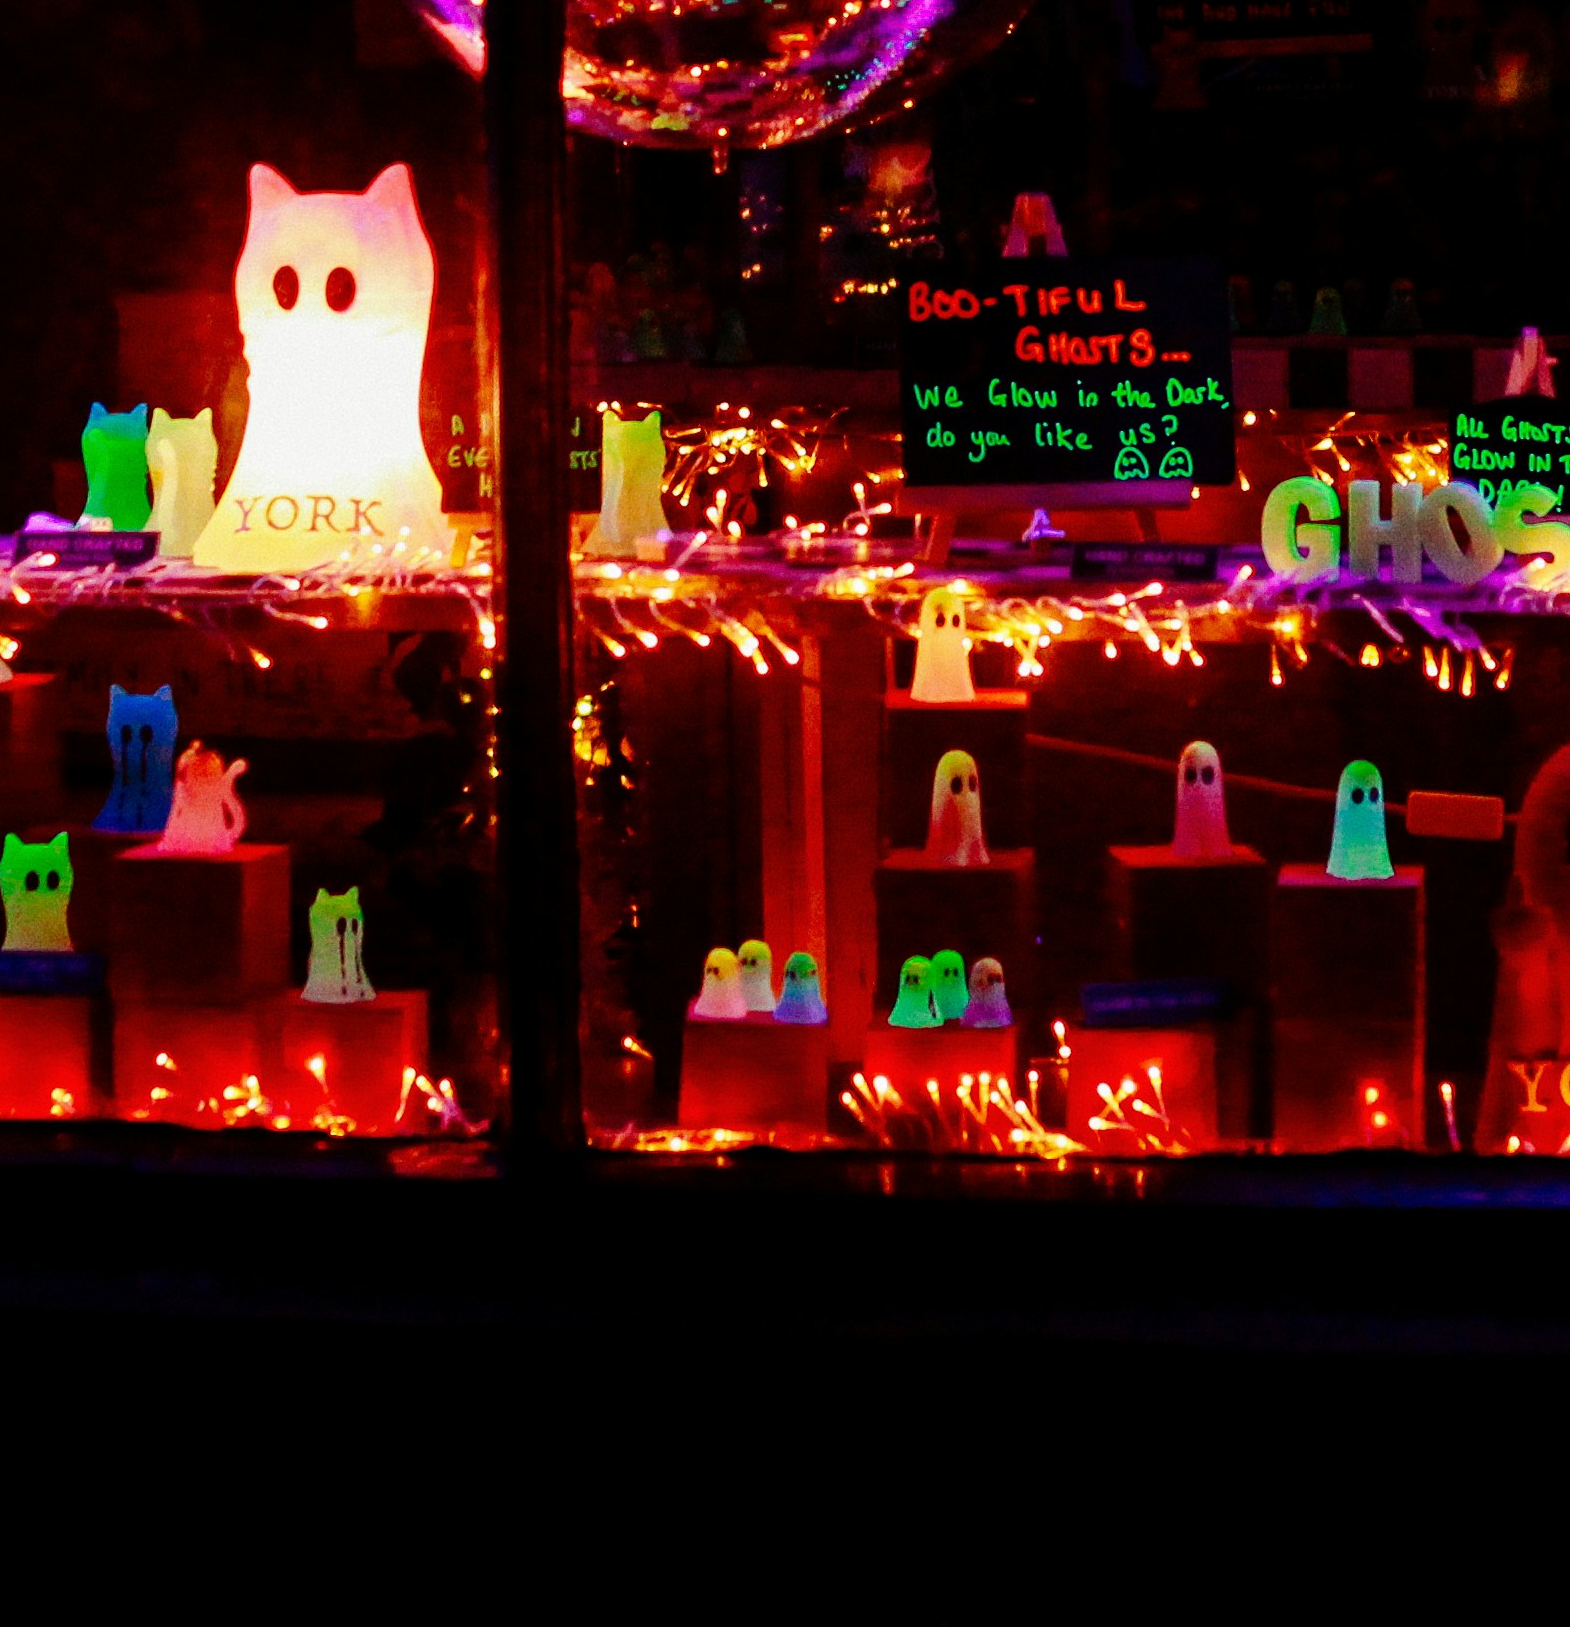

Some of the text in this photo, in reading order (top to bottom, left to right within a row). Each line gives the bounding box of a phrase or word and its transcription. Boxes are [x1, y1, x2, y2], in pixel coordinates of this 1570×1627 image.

[908, 279, 1147, 322] BOO-TIFUL
[987, 377, 1058, 410] Glow
[1077, 379, 1100, 409] in
[1111, 379, 1156, 410] the
[926, 421, 956, 449] do
[968, 433, 1012, 463] you
[1034, 422, 1094, 451] like
[1456, 413, 1490, 439] ALL
[1453, 442, 1516, 471] GLOW
[1529, 453, 1552, 473] IN
[232, 494, 386, 537] YORK
